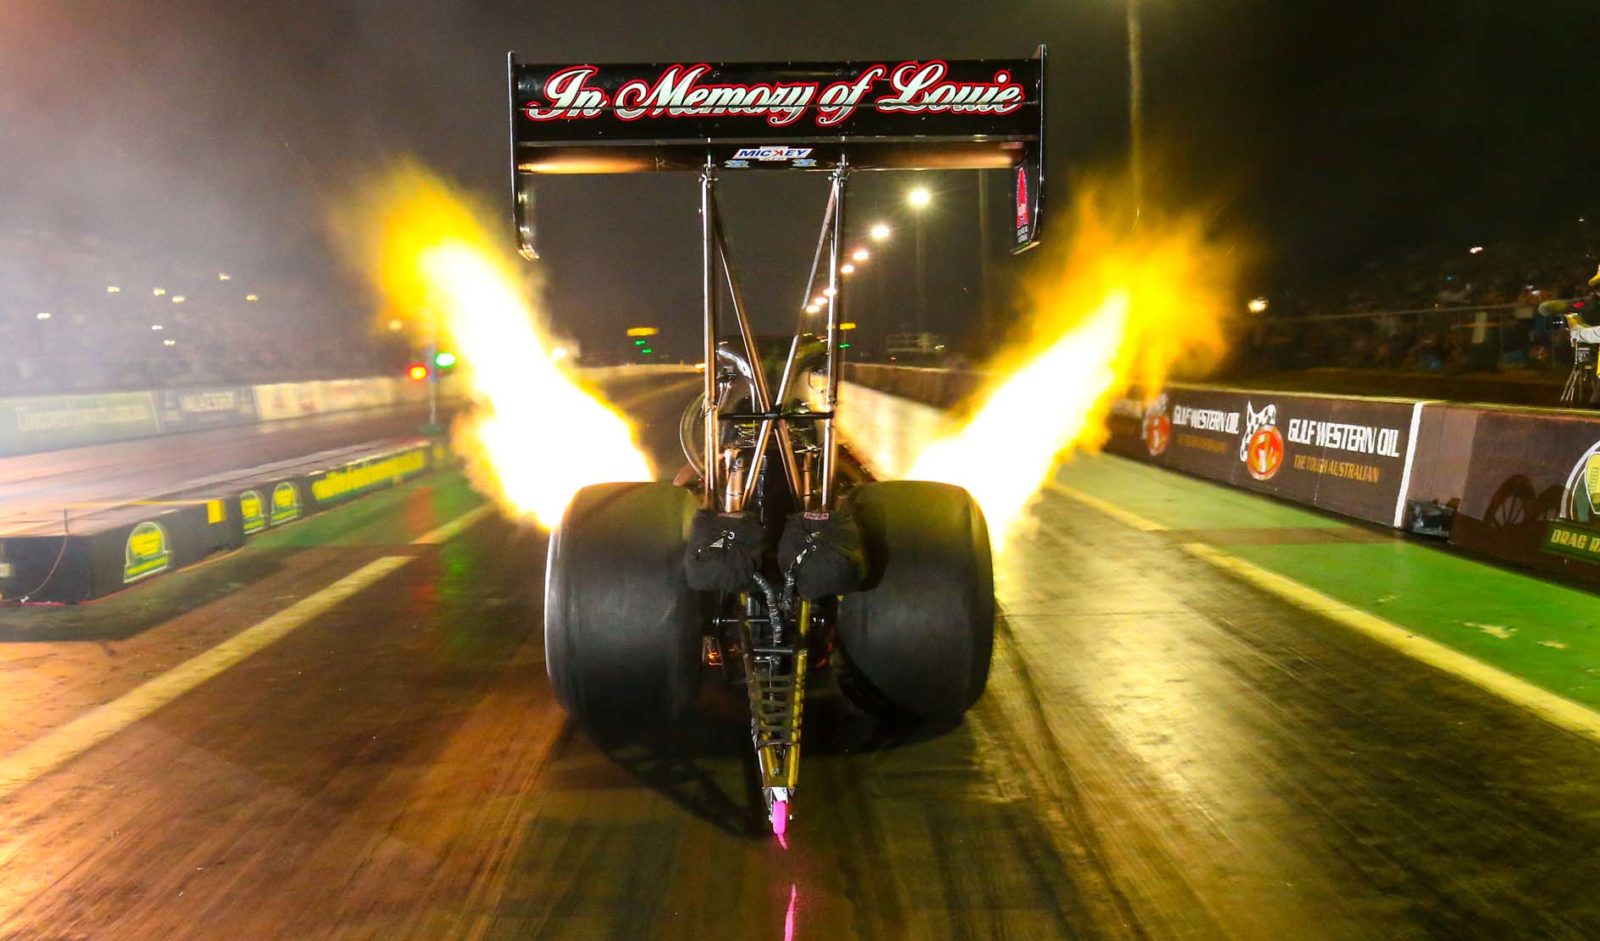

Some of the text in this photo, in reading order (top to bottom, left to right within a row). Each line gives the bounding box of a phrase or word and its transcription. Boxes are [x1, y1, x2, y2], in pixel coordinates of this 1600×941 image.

[525, 60, 1024, 126] In Memory of Louie
[1225, 412, 1240, 434] OIL
[1287, 418, 1400, 458] GULF WESTERN OIL
[1327, 459, 1380, 482] AUSTRALIAN
[1550, 529, 1588, 549] DRAG
